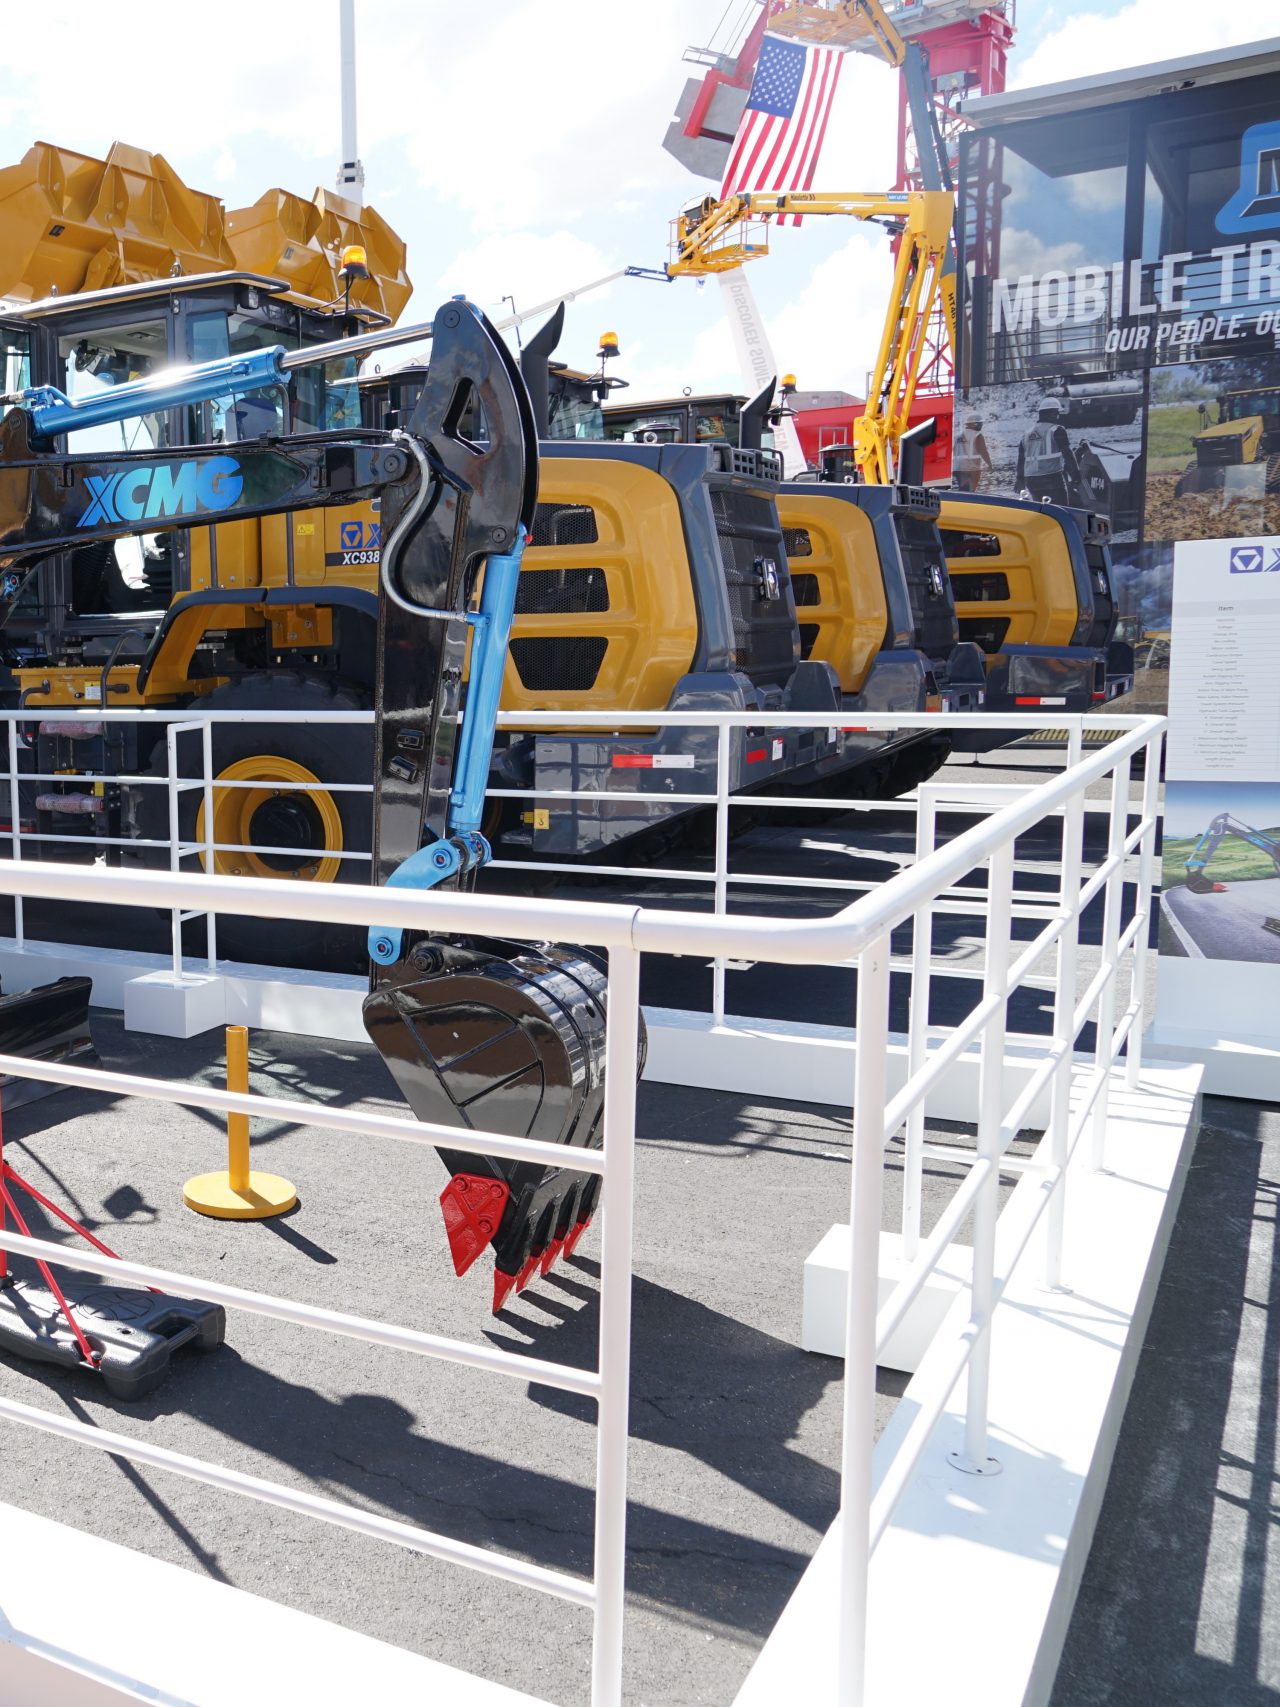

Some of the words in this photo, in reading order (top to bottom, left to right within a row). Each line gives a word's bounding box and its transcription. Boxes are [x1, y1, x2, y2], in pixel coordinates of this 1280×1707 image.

[991, 251, 1193, 334] MOBILE
[1211, 239, 1280, 304] TR
[1104, 325, 1151, 354] OUR
[1153, 313, 1248, 348] PEOPLE.
[75, 455, 244, 528] XCMG
[342, 551, 380, 565] XC938
